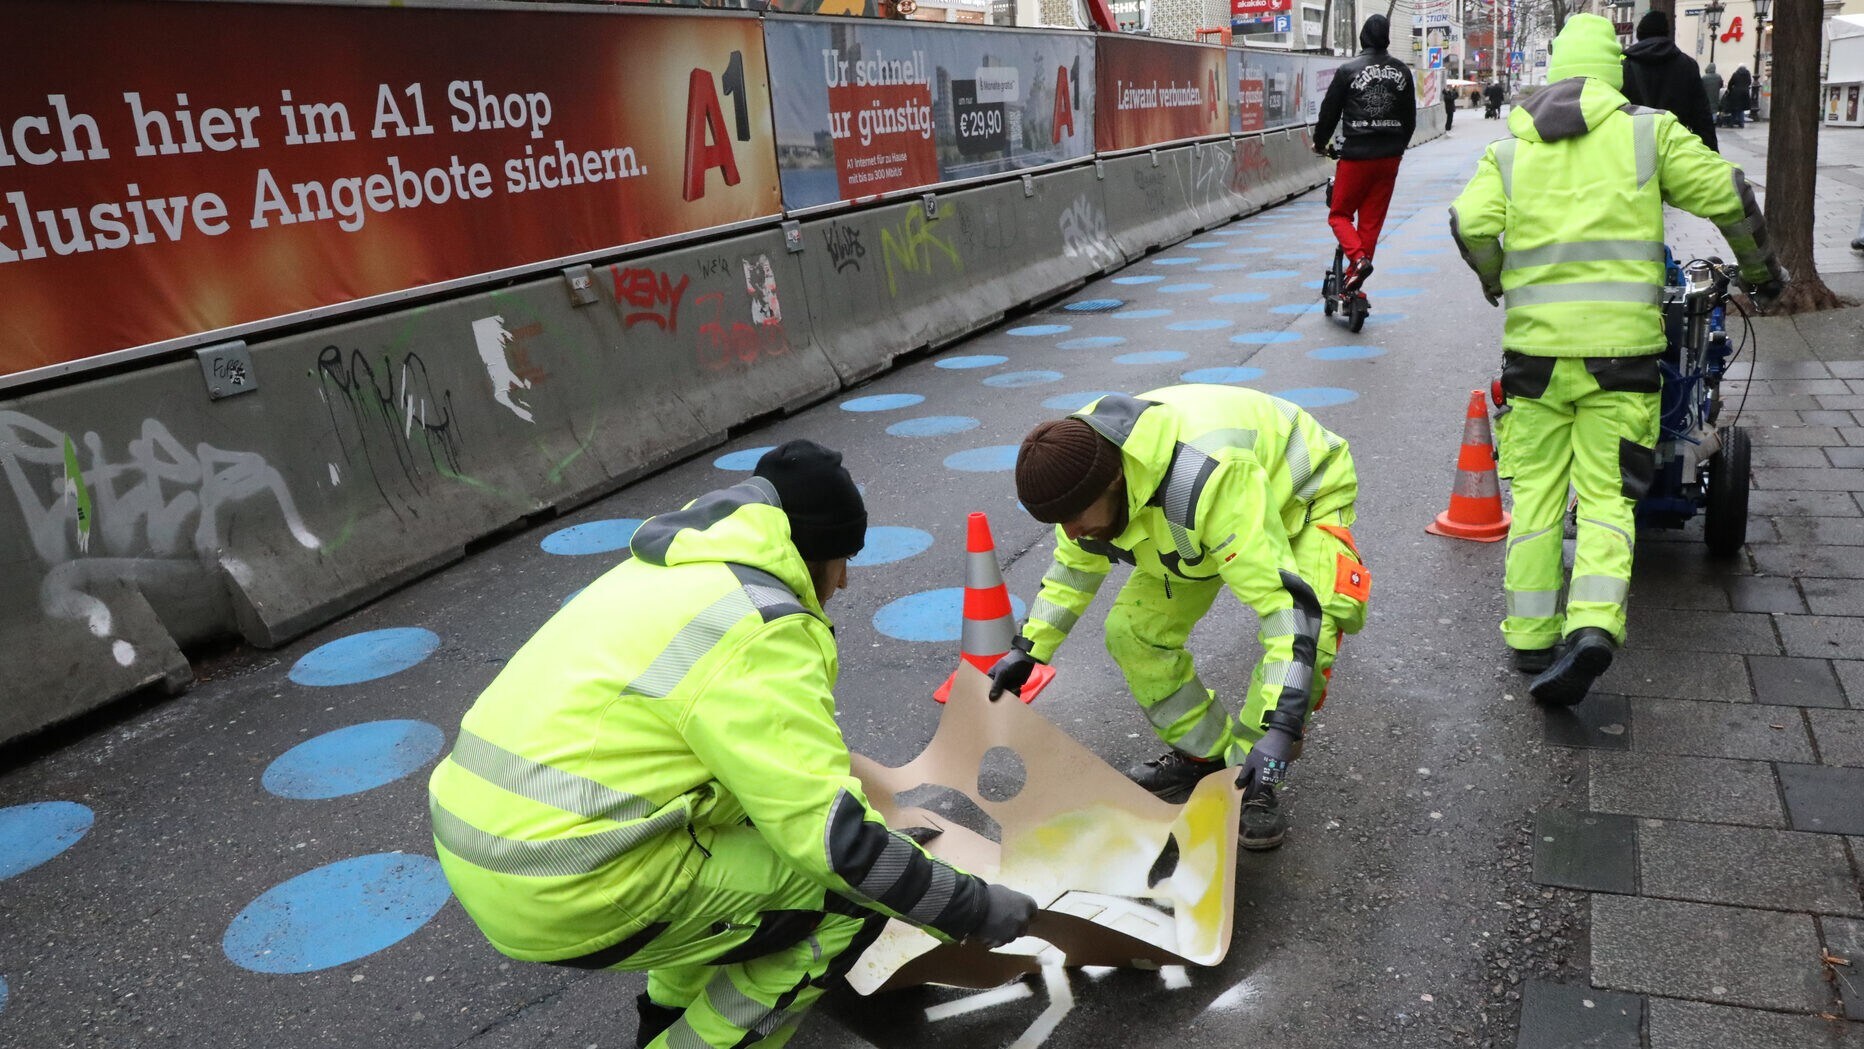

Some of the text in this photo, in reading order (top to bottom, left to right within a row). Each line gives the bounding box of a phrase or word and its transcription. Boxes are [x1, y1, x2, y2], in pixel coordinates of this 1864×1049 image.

[1418, 14, 1448, 23] ATION
[822, 49, 931, 91] Ur schnell,
[123, 92, 261, 156] hier
[281, 90, 355, 146] im
[372, 83, 434, 139] A1
[450, 80, 552, 138] Shop
[1052, 55, 1080, 145] A1
[1117, 80, 1203, 110] Leiwand verbunden.
[683, 50, 750, 202] A1
[827, 98, 935, 146] ur günstig.
[960, 113, 969, 138] €
[970, 110, 1002, 139] 29,90
[250, 155, 492, 233] Angebote
[506, 141, 648, 194] sichern.
